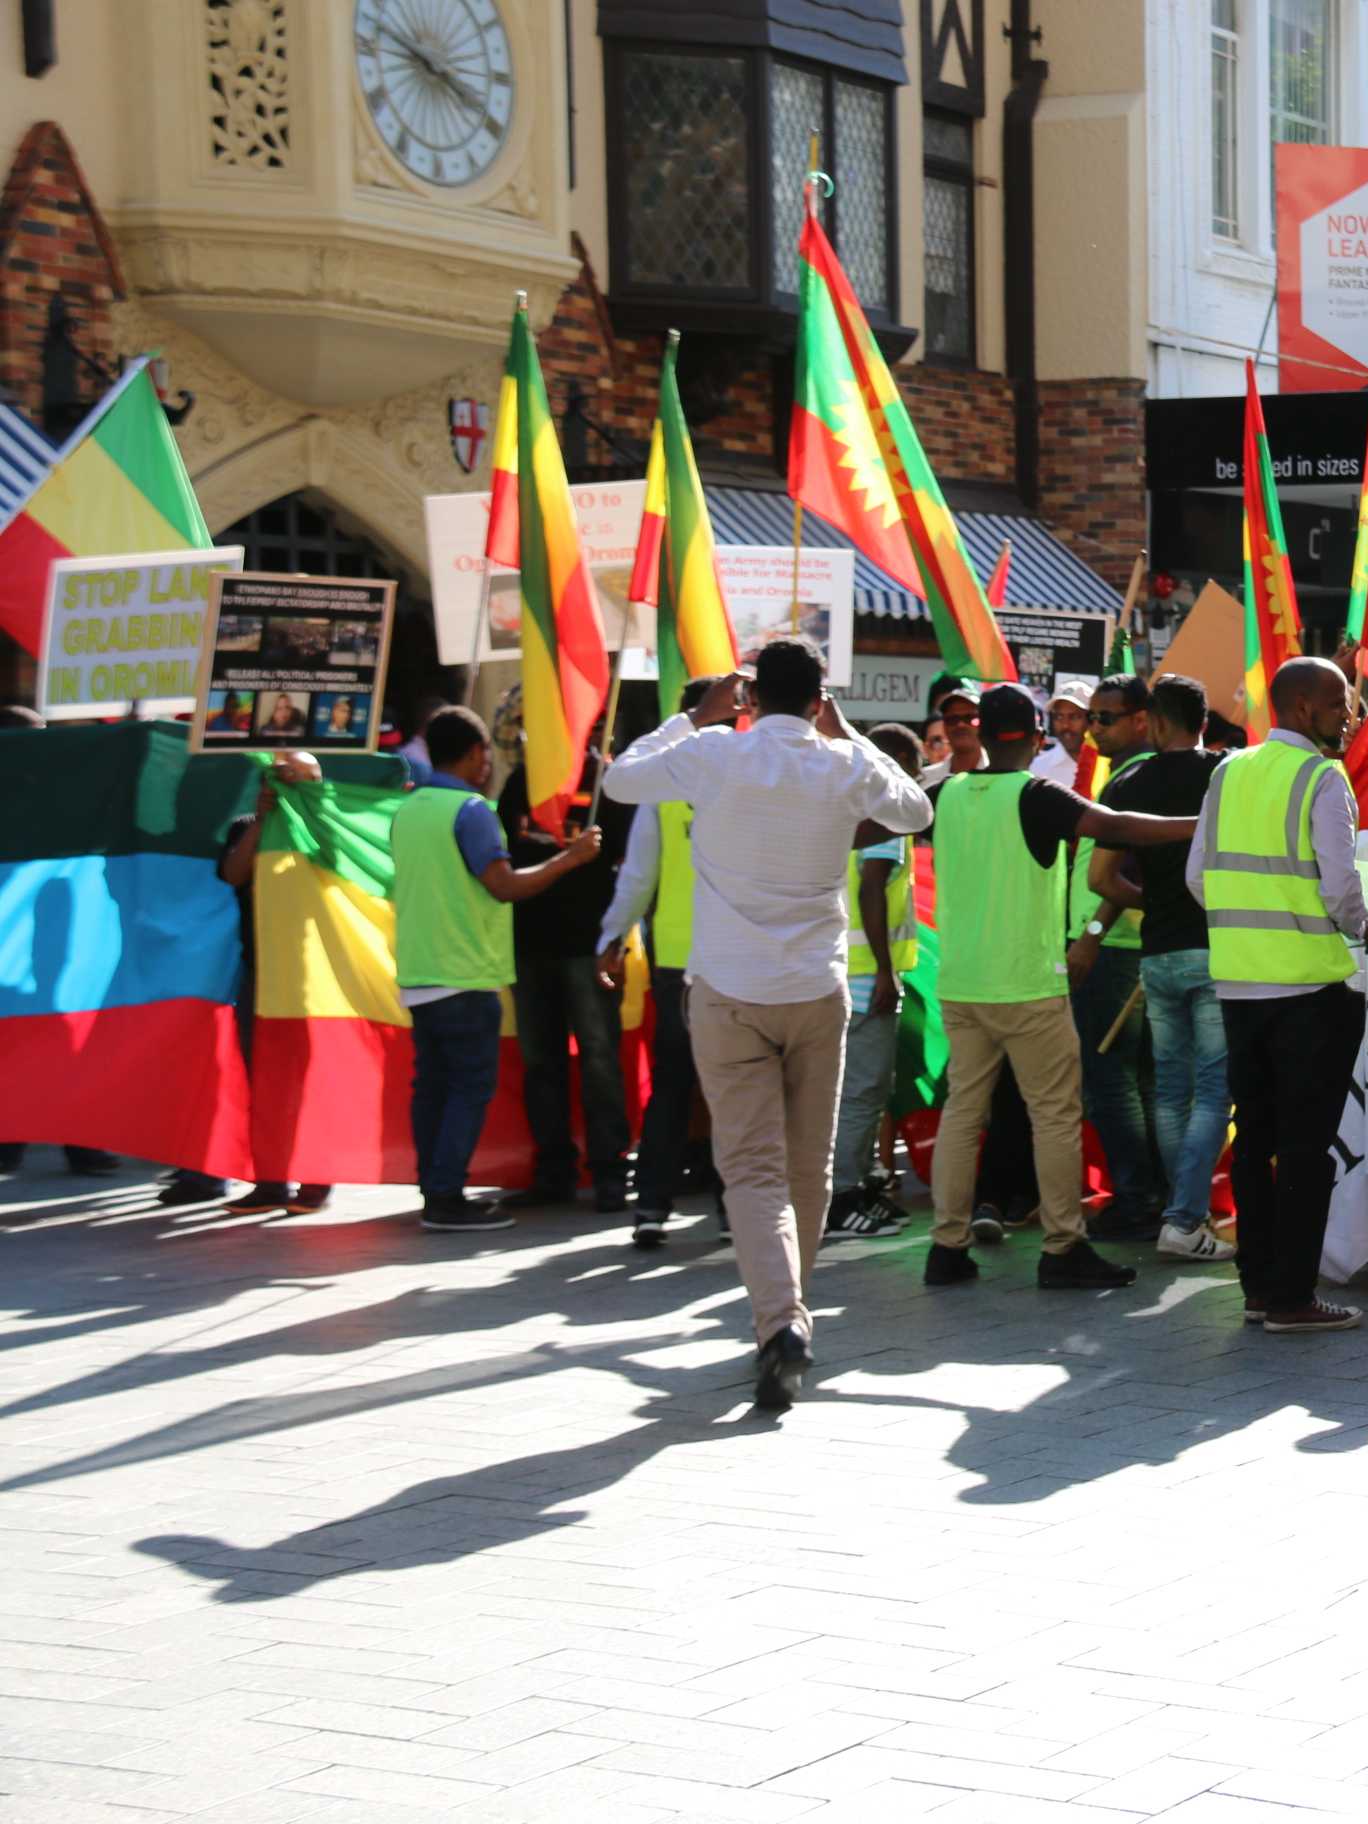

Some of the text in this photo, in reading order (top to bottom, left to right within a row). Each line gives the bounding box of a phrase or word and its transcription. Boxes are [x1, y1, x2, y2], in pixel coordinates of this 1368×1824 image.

[1327, 265, 1364, 278] PRIME
[1215, 457, 1238, 480] be
[1297, 455, 1313, 477] in
[1316, 454, 1360, 477] sizes
[63, 569, 141, 611] STOP
[62, 611, 201, 657] GRABBIN
[48, 658, 196, 705] IN OROMI
